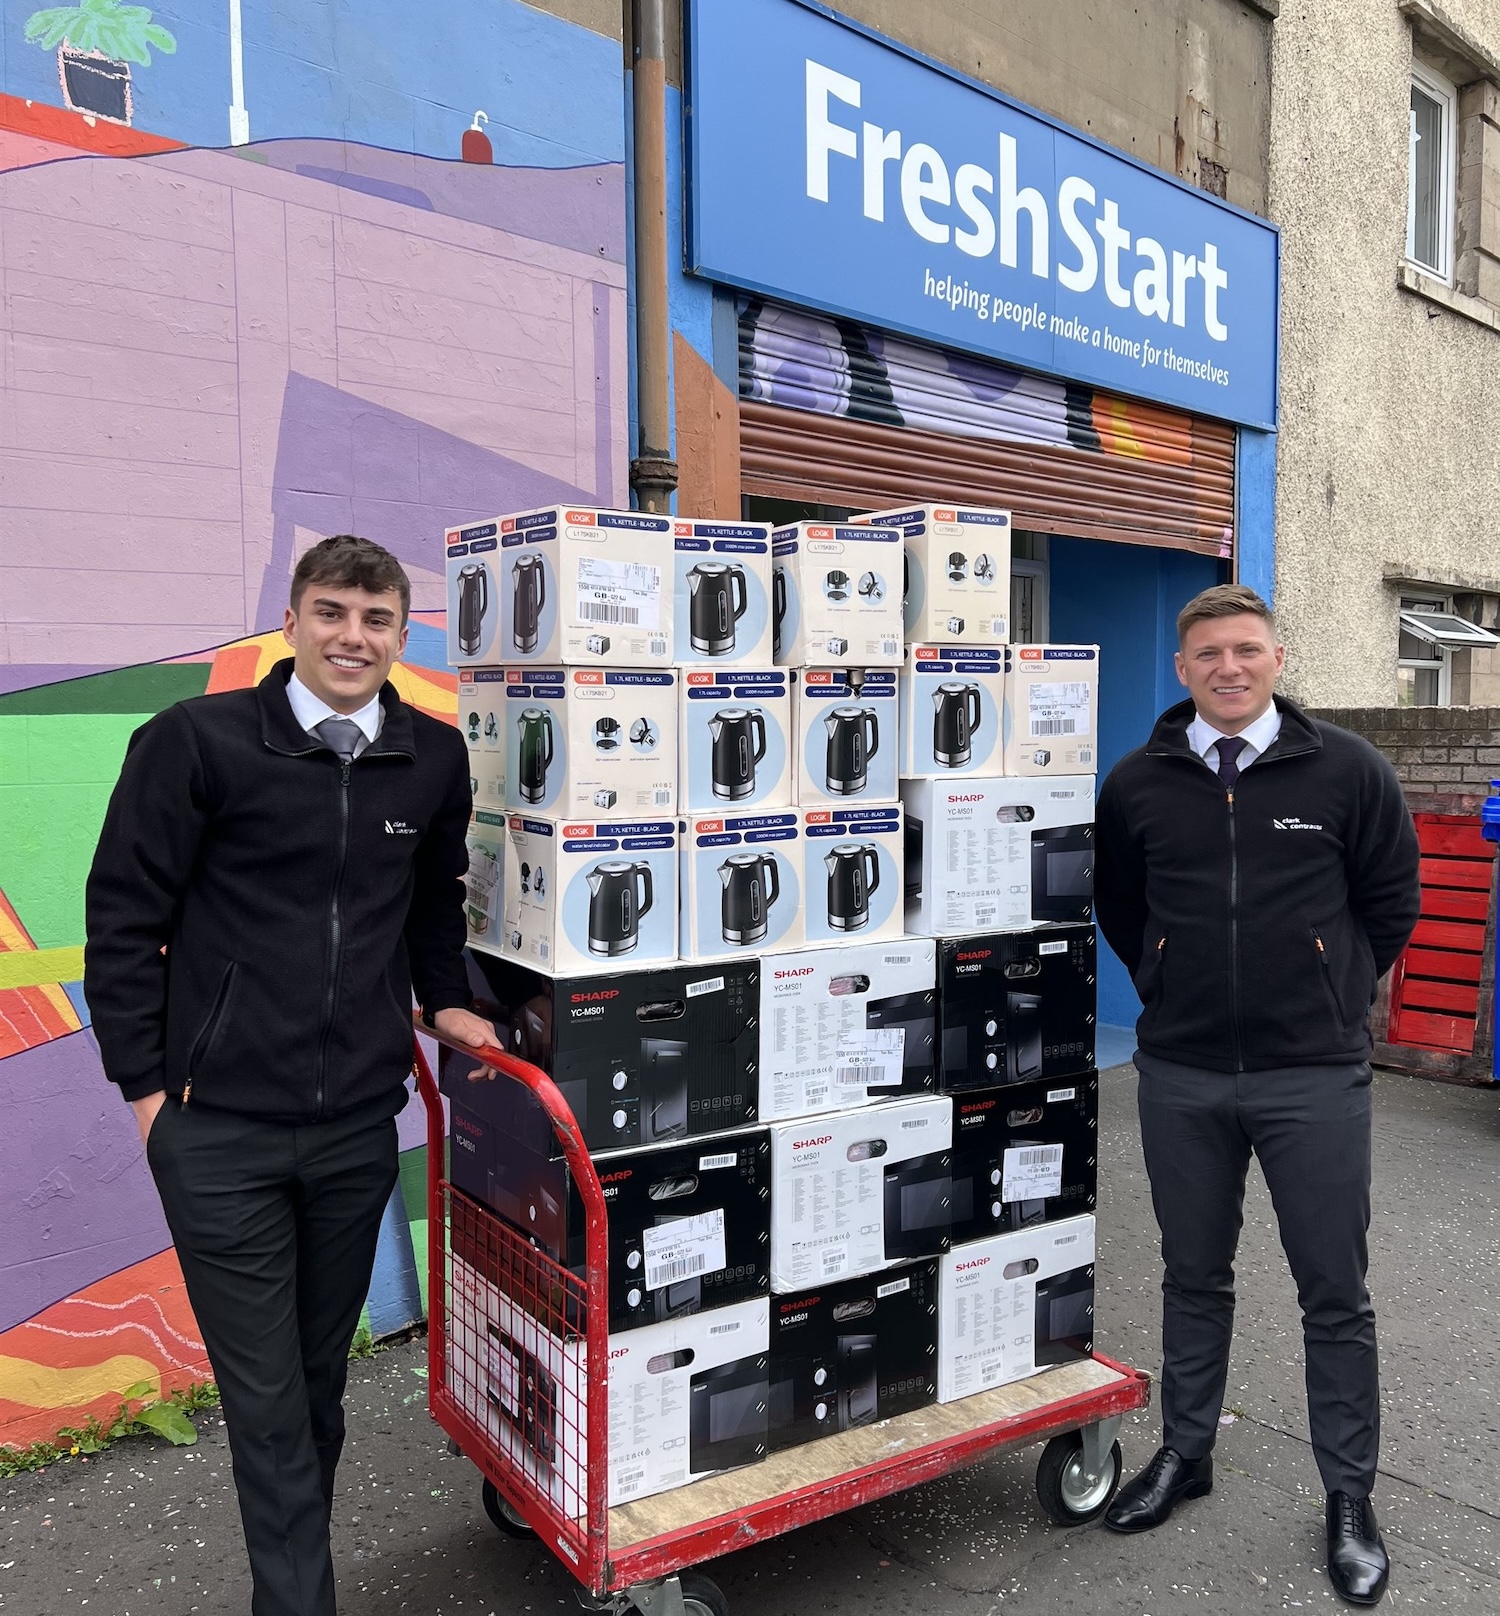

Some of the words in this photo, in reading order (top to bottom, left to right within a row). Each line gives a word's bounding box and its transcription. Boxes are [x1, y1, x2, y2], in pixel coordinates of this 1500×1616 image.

[924, 268, 991, 320] helping
[992, 297, 1047, 332] people
[1049, 314, 1090, 344] make
[1091, 330, 1101, 348] a
[1103, 326, 1141, 360] home
[1141, 338, 1162, 368] for
[1163, 347, 1230, 387] themselves
[571, 514, 591, 523] LOGIK
[938, 512, 952, 520] LOGIK
[618, 519, 637, 527] KETTLE
[674, 526, 688, 534] OGIK
[812, 529, 830, 537] LOGIK
[580, 674, 598, 682] LOGIK
[948, 794, 985, 803] SHARP
[947, 808, 973, 816] YC-MS01
[701, 823, 718, 831] LOGIK
[1289, 823, 1323, 831] contracts
[956, 950, 992, 961] SHARP
[774, 967, 814, 979] SHARP
[955, 964, 982, 973] YC-MS01
[774, 983, 802, 992] YC-MS01
[570, 990, 620, 1003] SHARP
[570, 1006, 605, 1017] YC-MS01
[961, 1101, 996, 1113] SHARP
[960, 1115, 985, 1126] YC-MS01
[793, 1135, 832, 1150] SHARP
[792, 1151, 820, 1163] YC-MS01
[599, 1170, 633, 1183] HARP
[955, 1256, 990, 1272] SHARP
[955, 1272, 980, 1284] YC-MS01
[780, 1296, 821, 1313] SHARP
[780, 1312, 808, 1326] YC-MS01
